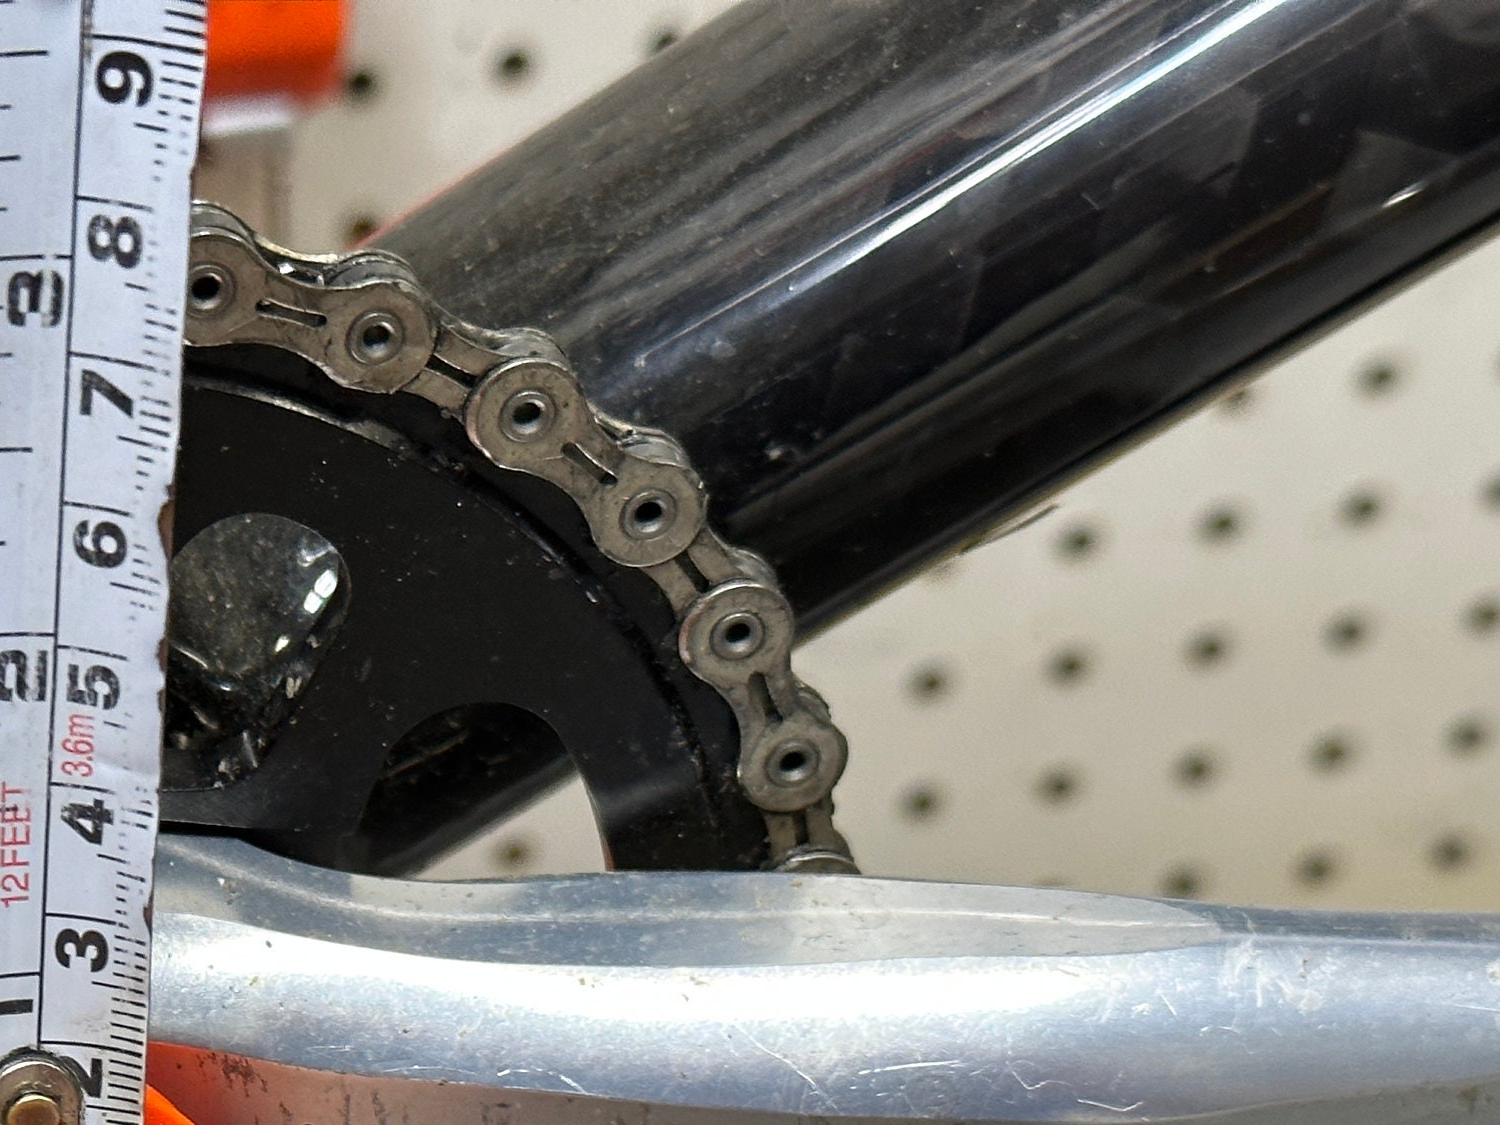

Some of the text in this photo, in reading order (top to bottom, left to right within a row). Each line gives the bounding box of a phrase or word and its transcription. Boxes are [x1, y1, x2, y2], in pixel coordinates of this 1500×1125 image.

[94, 51, 153, 107] 9
[87, 213, 142, 269] 8
[6, 270, 63, 326] 3
[79, 369, 134, 418] 7
[72, 519, 127, 568] 6
[66, 663, 120, 710] 5
[60, 713, 95, 777] 3.6m
[0, 780, 32, 908] 12 FEET
[60, 799, 114, 845] 4
[55, 927, 109, 973] 3
